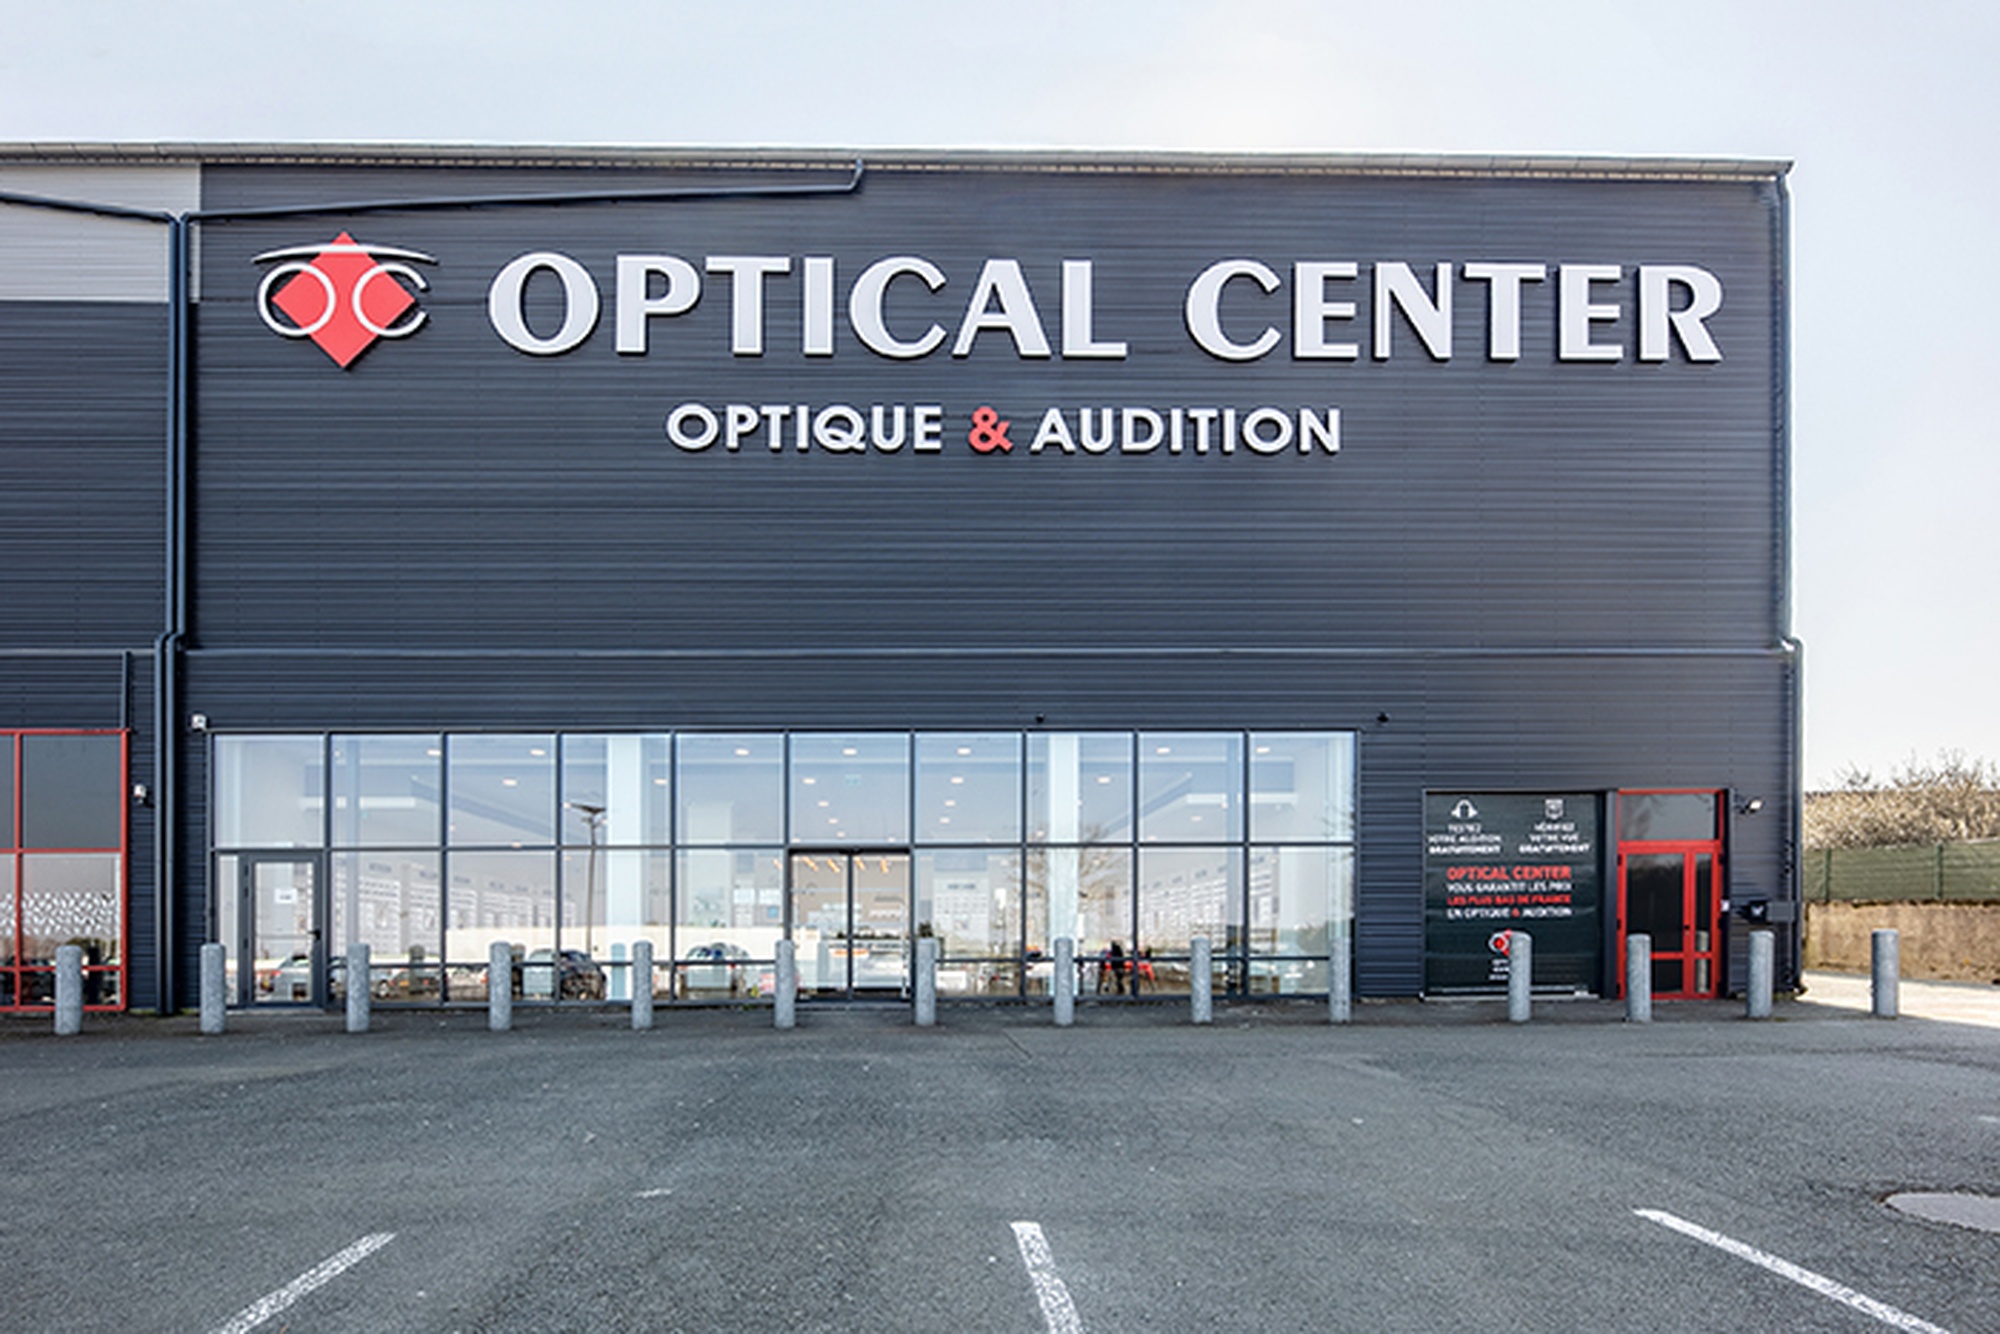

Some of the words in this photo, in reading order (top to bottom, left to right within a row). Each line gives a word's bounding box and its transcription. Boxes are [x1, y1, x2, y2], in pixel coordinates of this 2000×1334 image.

[488, 251, 1128, 358] OPTICAL
[1186, 259, 1723, 362] CENTER
[666, 403, 943, 453] OPTIQUE
[968, 406, 1013, 453] &
[1030, 406, 1342, 454] AUDITION
[1446, 866, 1510, 881] OPTICAL
[1512, 865, 1572, 880] CENTER
